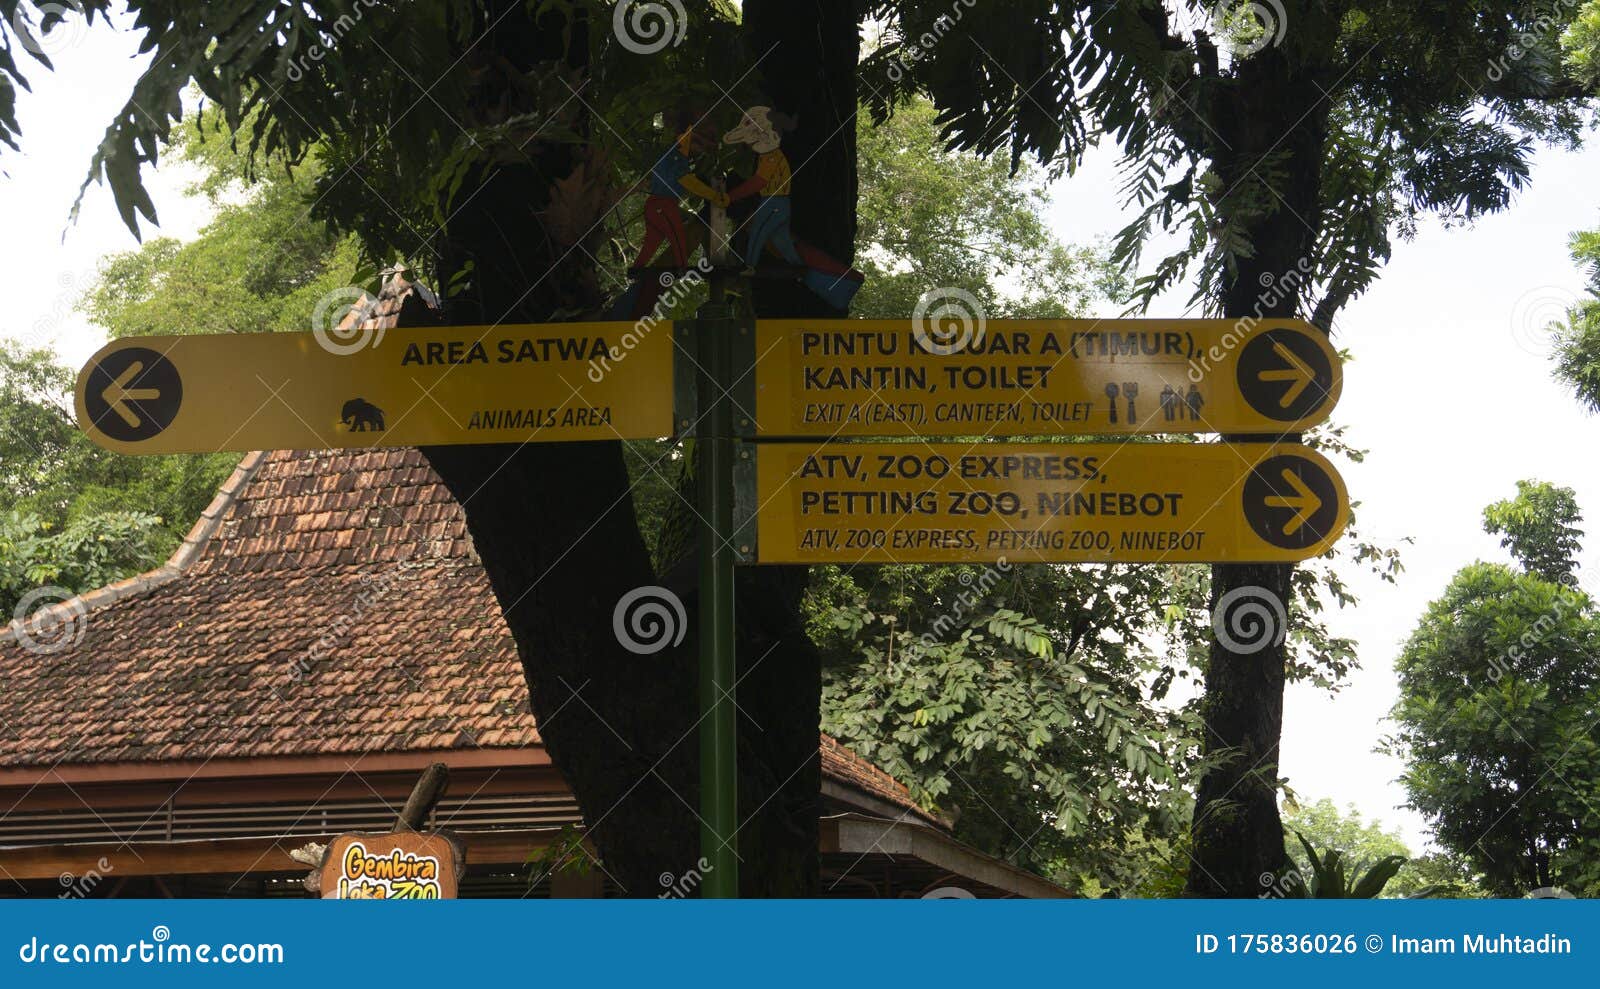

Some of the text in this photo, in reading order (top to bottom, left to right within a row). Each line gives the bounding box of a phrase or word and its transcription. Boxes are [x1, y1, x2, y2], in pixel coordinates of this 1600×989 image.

[401, 337, 612, 366] AREA SATWA
[802, 332, 897, 355] PINTU
[1040, 332, 1062, 354] A
[1071, 332, 1203, 358] (TIMUR),
[804, 366, 1052, 393] KANTIN, TOILET
[468, 407, 611, 430] ANIMALS AREA
[804, 402, 1093, 425] EXIT A (EAST), CANTEEN, TOILET
[800, 455, 1107, 483] ATV, ZOO EXPRESS,
[802, 490, 1183, 519] PETTING ZOO, NINEBOT
[801, 529, 1206, 553] ATV, ZOO EXPRESS, PETTING ZOO, NINEBOT
[344, 844, 436, 881] Gembira
